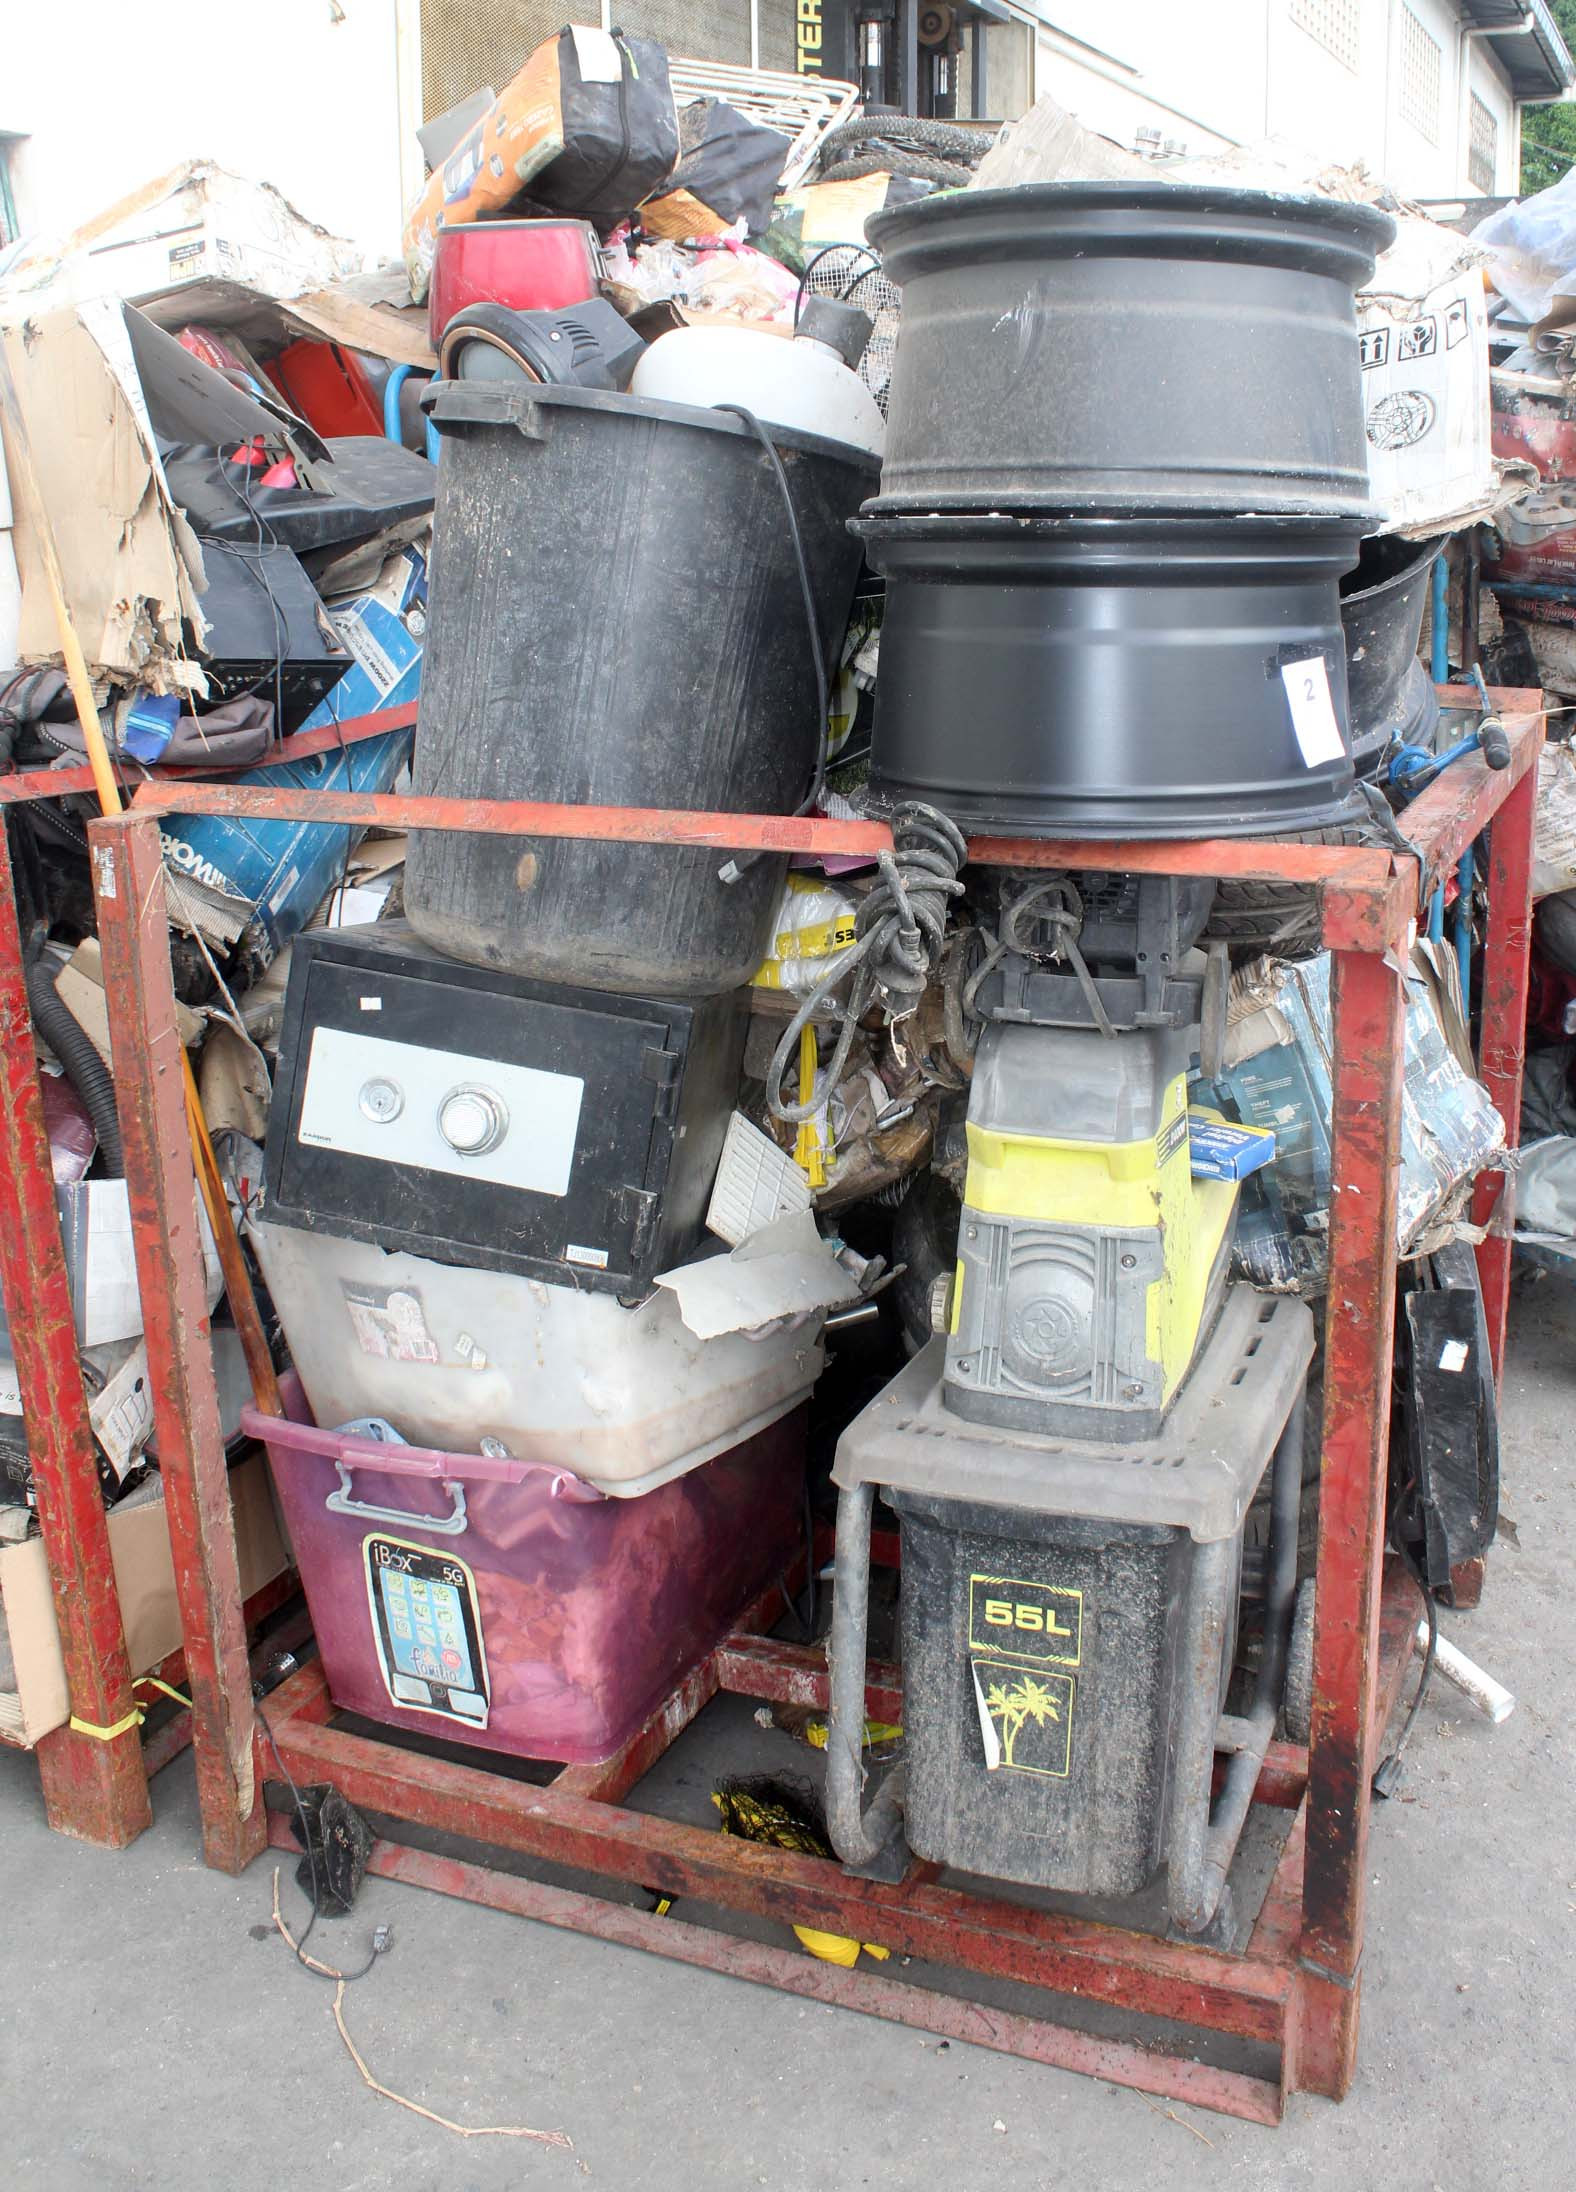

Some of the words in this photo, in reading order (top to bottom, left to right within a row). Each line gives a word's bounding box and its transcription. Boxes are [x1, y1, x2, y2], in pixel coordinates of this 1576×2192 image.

[1303, 678, 1316, 702] 2
[442, 1566, 464, 1583] 5G
[984, 1599, 1073, 1637] 55L
